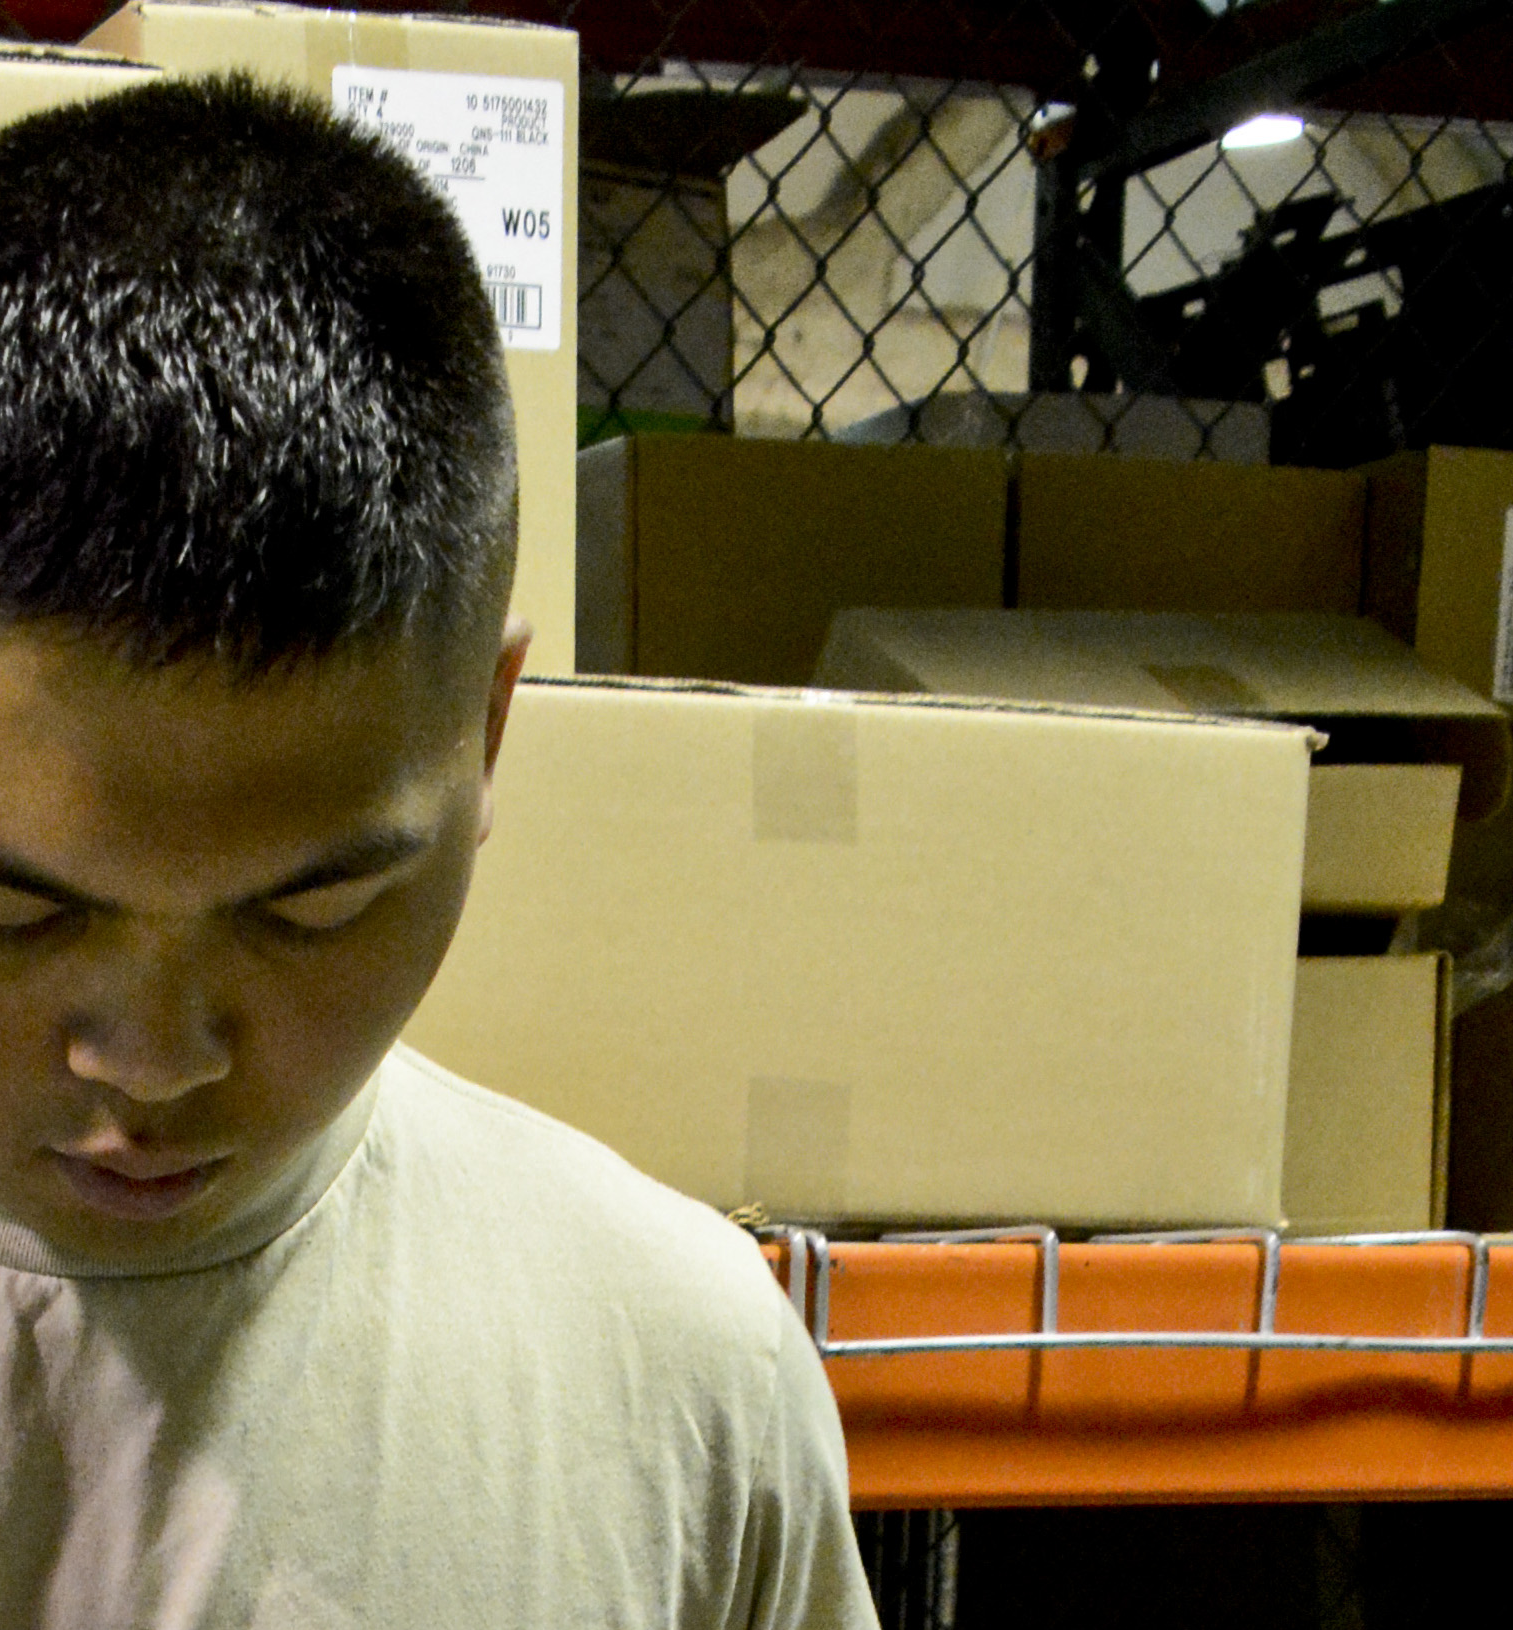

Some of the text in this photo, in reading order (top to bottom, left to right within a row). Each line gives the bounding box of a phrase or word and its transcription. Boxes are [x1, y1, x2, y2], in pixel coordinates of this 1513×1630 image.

[348, 86, 374, 104] ITEM
[502, 113, 547, 130] PRODUCT
[517, 129, 549, 145] BLACK
[416, 140, 449, 153] ORIGIN
[459, 142, 489, 156] CHINA
[502, 208, 550, 240] W05
